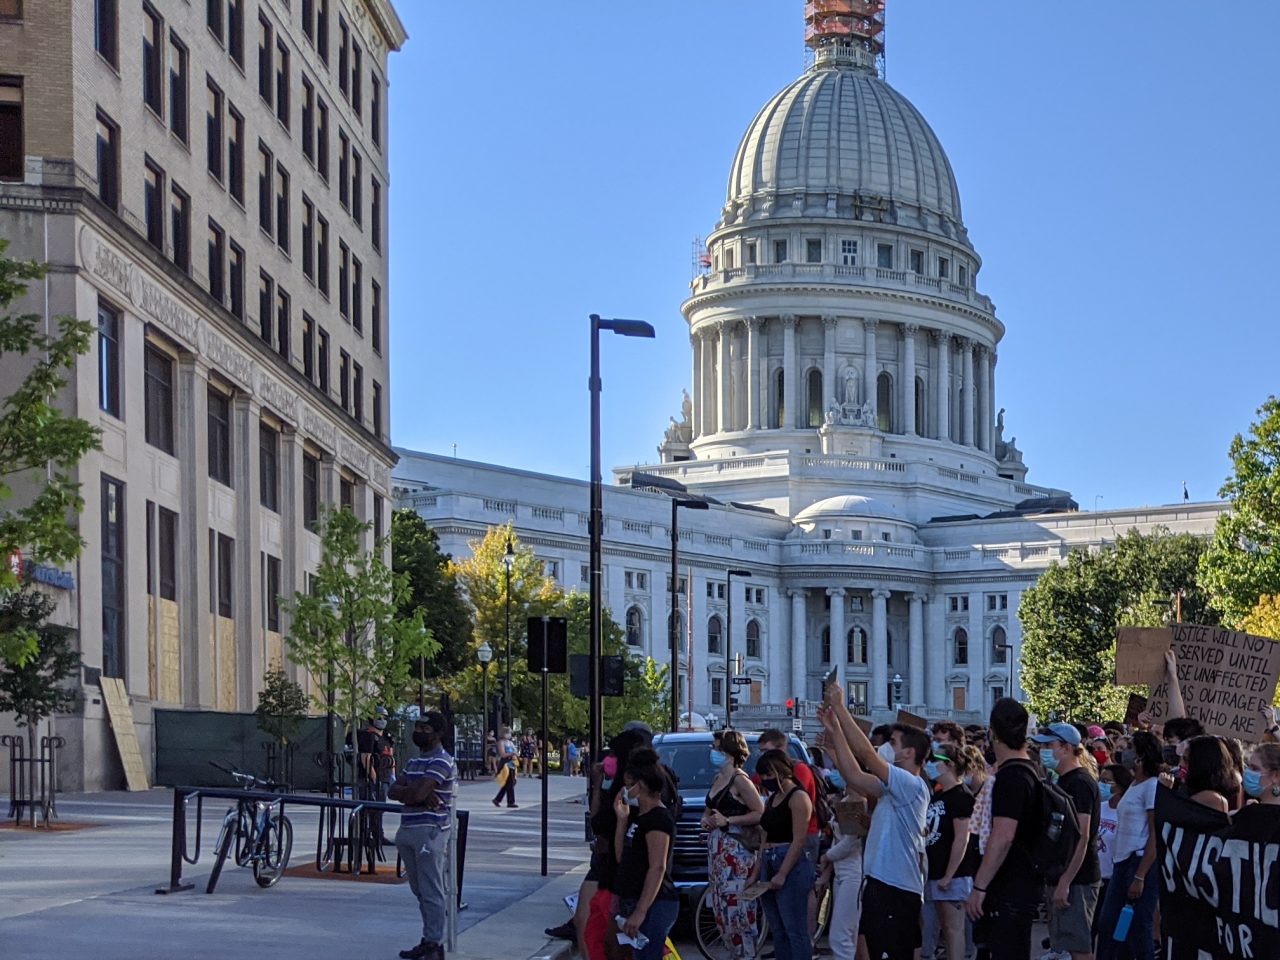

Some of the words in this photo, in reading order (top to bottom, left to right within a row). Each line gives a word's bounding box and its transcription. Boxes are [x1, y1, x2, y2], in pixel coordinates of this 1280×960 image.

[1170, 625, 1210, 642] JUSTICE
[1212, 629, 1238, 648] WILL
[1243, 636, 1279, 655] NOT
[1178, 644, 1224, 665] SERVED
[1229, 652, 1271, 676] UNTIL
[1194, 667, 1268, 692] UNAFFECTED
[1153, 683, 1168, 699] AR
[1180, 685, 1194, 701] AS
[1199, 687, 1267, 713] OUTRAGED
[1150, 701, 1161, 717] AS
[1164, 702, 1198, 719] TSE
[1199, 708, 1227, 726] WHO
[1216, 916, 1254, 959] FOR
